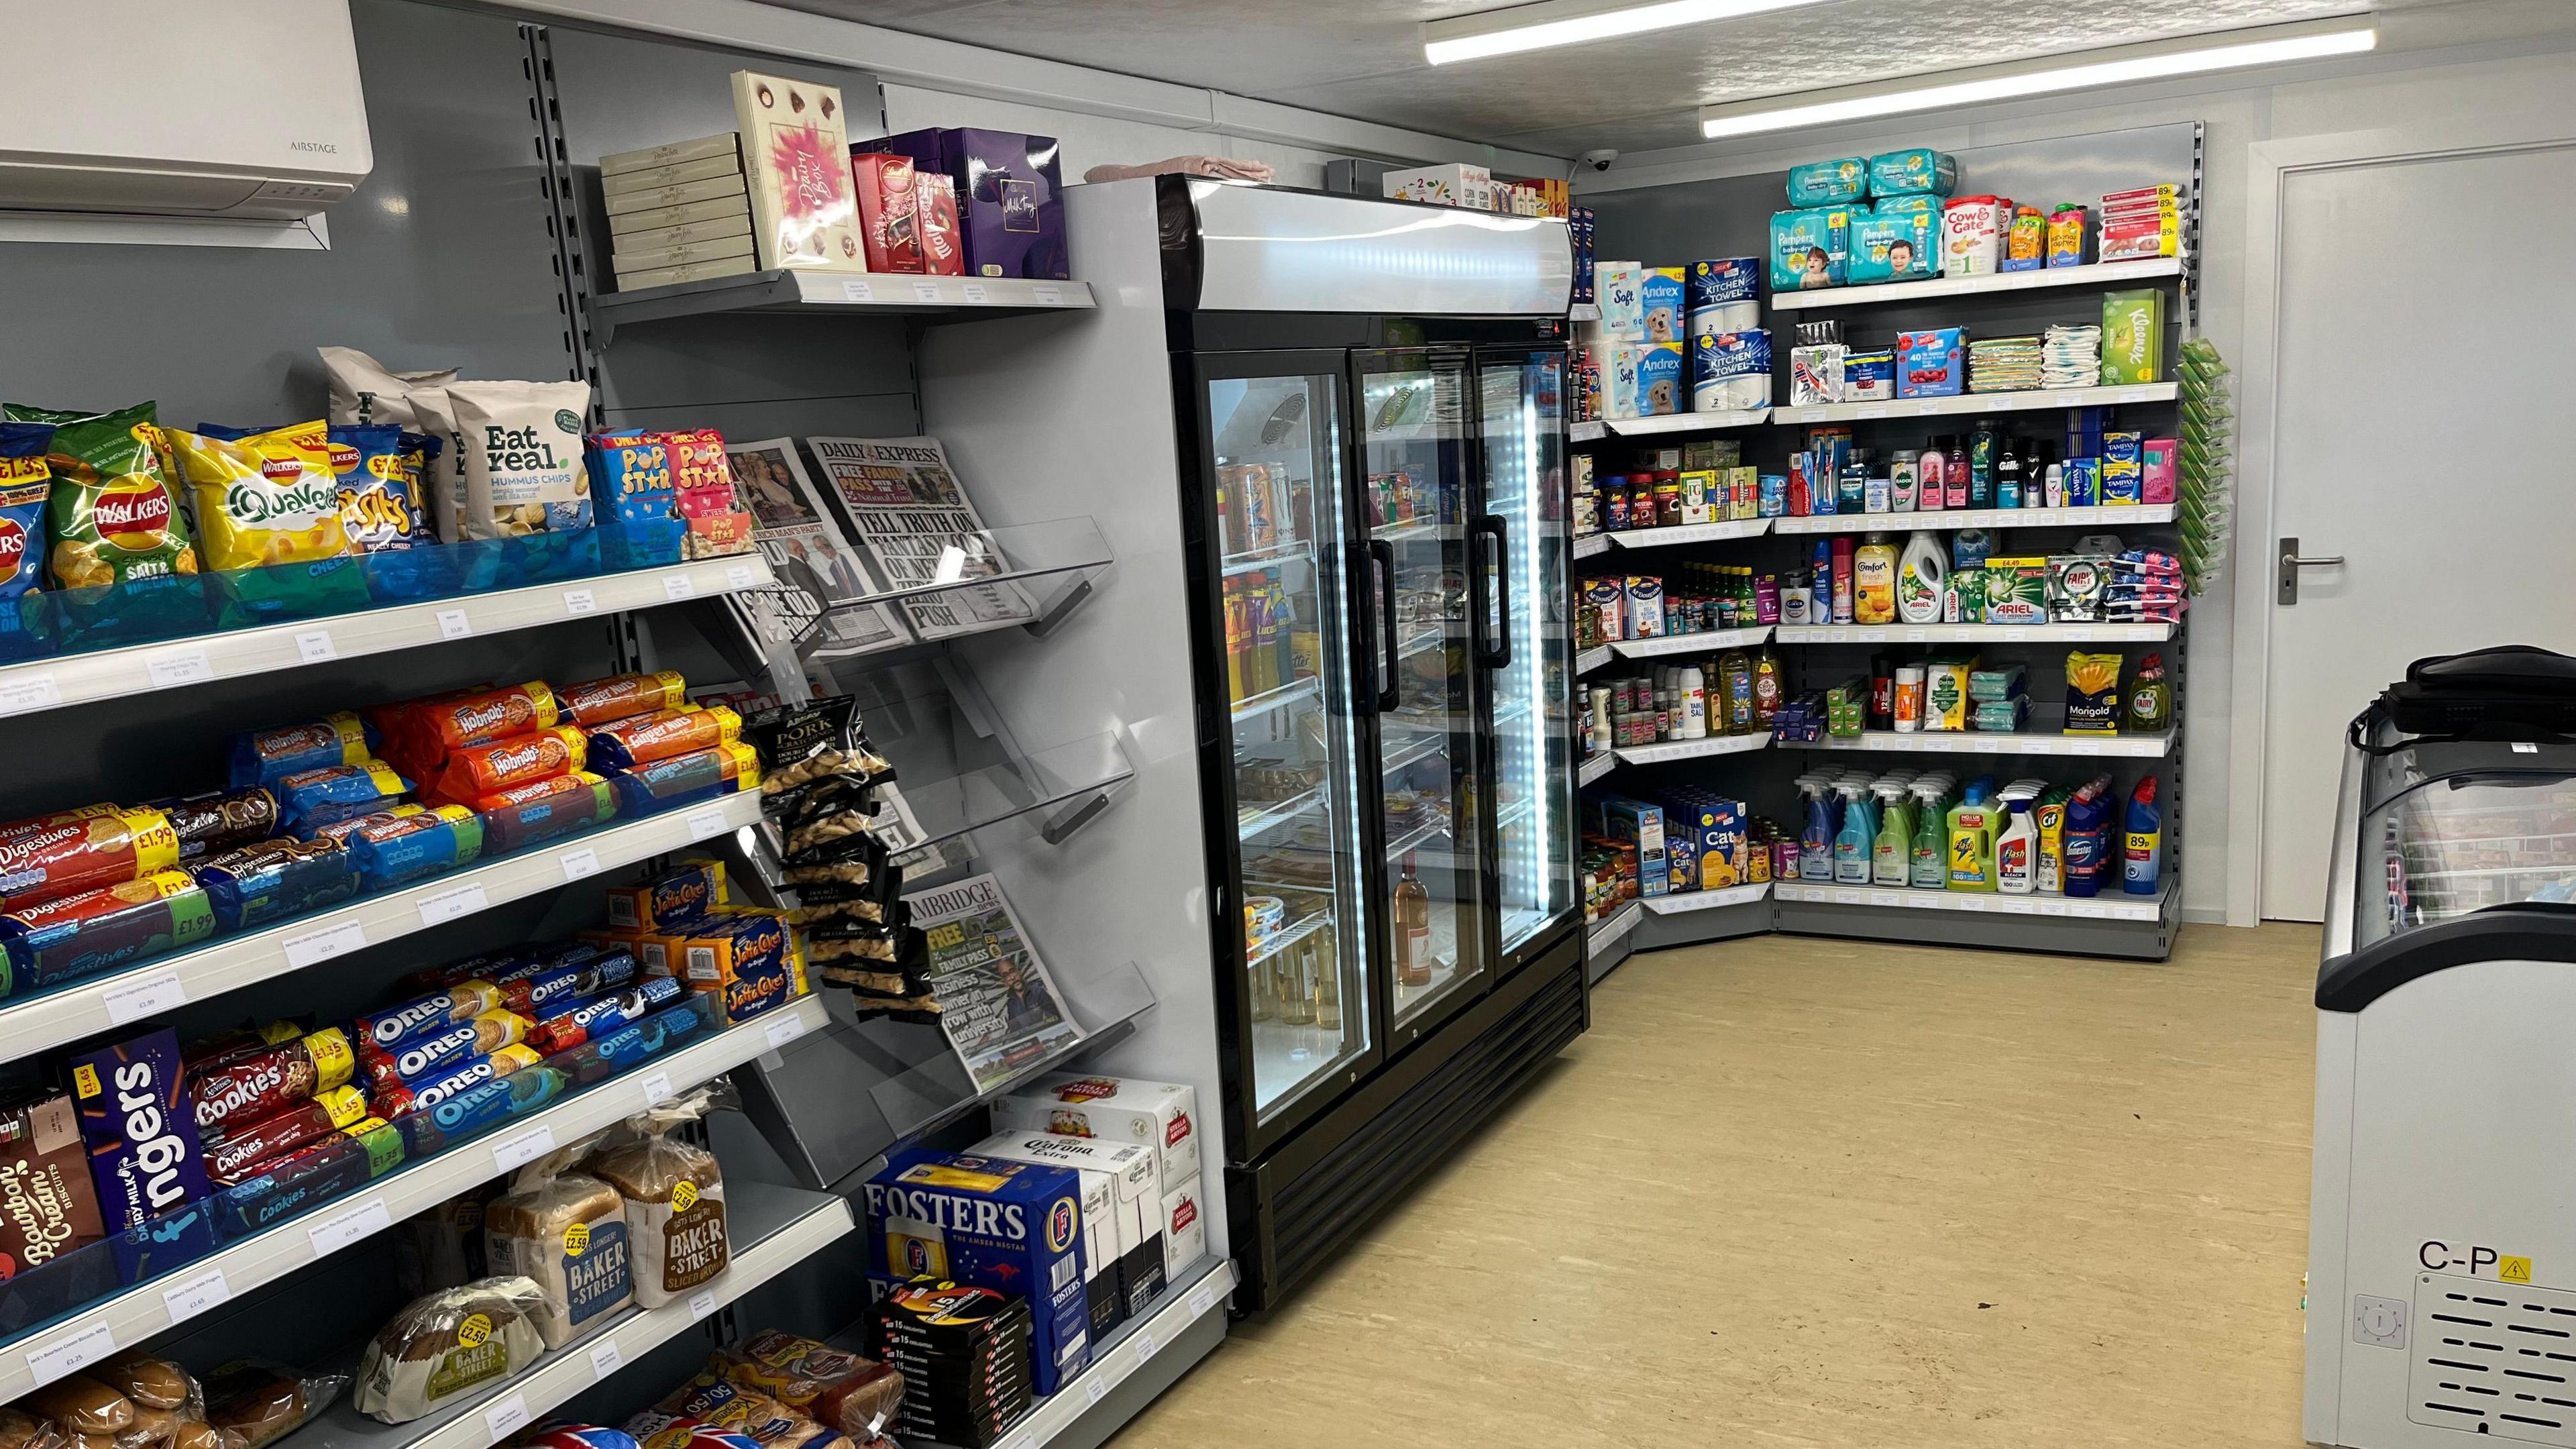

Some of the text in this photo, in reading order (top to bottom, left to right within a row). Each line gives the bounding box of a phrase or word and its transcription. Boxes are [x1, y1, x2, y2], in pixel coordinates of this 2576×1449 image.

[290, 142, 337, 154] AIRSTAGE
[1417, 178, 1424, 188] 2
[2159, 187, 2170, 195] 89p
[1479, 191, 1489, 201] CORN
[2160, 199, 2172, 207] 89p
[1948, 208, 1990, 223] Cow &
[1863, 229, 1895, 239] Pampers
[1953, 220, 1984, 233] Gate
[2162, 228, 2174, 236] 89p
[1778, 234, 1814, 246] Pampers
[1963, 256, 1971, 273] 1
[1644, 286, 1678, 297] Andrex
[1706, 278, 1747, 295] KITCHEN
[1614, 290, 1635, 304] Soft
[1711, 290, 1743, 303] TOWEL
[2129, 308, 2149, 365] Kleenex
[1644, 358, 1679, 370] Andrex
[1711, 352, 1752, 368] KITCHEN
[1911, 353, 1921, 361] 40
[1620, 368, 1634, 383] Soft
[1715, 362, 1749, 377] TOWEL
[486, 425, 539, 449] Eat
[818, 442, 941, 463] DAILY EXPRESS
[2108, 443, 2135, 451] TAMPAX
[488, 443, 556, 472] real
[262, 461, 303, 474] WALKERS
[491, 474, 571, 487] HUMMUS CHIPS
[839, 477, 874, 492] PASS
[2107, 479, 2134, 488] TAMPAX
[857, 491, 913, 502] National Trust
[1688, 484, 1701, 497] PG
[94, 494, 169, 525] WALKERS
[757, 523, 825, 539] RICH MAN'S PARTY
[854, 512, 979, 534] TELL TRUTH ON
[367, 541, 412, 551] REALLY CHEESY
[125, 561, 169, 580] SALT &
[1858, 561, 1887, 572] Comfort
[2067, 572, 2093, 585] FAIRY
[909, 606, 961, 629] PUSH
[1996, 604, 2033, 614] ARIEL
[574, 679, 638, 710] Ginger Nuts
[2070, 705, 2110, 718] Marigold
[2136, 699, 2153, 708] FAIRY
[459, 702, 506, 735] Hobnobs
[1691, 709, 1704, 717] SALT
[629, 714, 692, 749] Ginger Nuts
[777, 719, 833, 745] PORK
[492, 745, 541, 775] Hobnobs
[2042, 812, 2056, 826] Cif
[0, 824, 81, 865] Digestives
[41, 839, 72, 853] ORIGINAL
[138, 826, 174, 849] £1.99
[1706, 831, 1734, 846] Cat
[1953, 838, 1974, 851] Flash
[2131, 836, 2149, 847] 89p
[2004, 848, 2026, 859] Flash
[21, 888, 105, 920] Digestives
[655, 881, 705, 917] Jaffa Cakes
[977, 898, 1001, 914] news
[178, 913, 213, 934] £1.99
[926, 923, 965, 951] FREE
[735, 931, 782, 968] Jaffa Cakes
[530, 973, 578, 1004] OREO
[729, 973, 784, 1012] Jaffa Cakes
[139, 1000, 155, 1008] £1.99
[574, 996, 618, 1025] OREO
[376, 996, 452, 1041] OREO
[418, 1020, 440, 1034] GOLDEN
[953, 1016, 1008, 1042] university
[598, 1028, 641, 1055] OREO
[315, 1042, 342, 1061] £1.35
[399, 1027, 477, 1075] OREO
[80, 1067, 91, 1094] £1.65
[417, 1063, 493, 1110] OREO
[196, 1065, 282, 1126] Cookies
[435, 1079, 511, 1125] OREO
[332, 1100, 360, 1118] £1.35
[217, 1137, 264, 1173] Cookies
[1024, 1139, 1095, 1156] Corona
[1032, 1148, 1069, 1160] Extra
[373, 1149, 397, 1168] £1.35
[48, 1163, 73, 1210] BISCUITS
[259, 1187, 306, 1223] Cookies
[672, 1191, 692, 1209] £2.59
[864, 1183, 1026, 1240] FOSTER'S
[566, 1238, 587, 1249] £2.59
[670, 1218, 724, 1258] BAKER
[953, 1234, 1026, 1252] THE AMBER NECTAR
[570, 1240, 626, 1291] BAKER
[676, 1243, 718, 1275] STREET
[2419, 1241, 2498, 1275] C-P
[579, 1269, 621, 1304] STREET
[1051, 1278, 1081, 1308] FOSTER'S
[190, 1297, 205, 1308] £1.65
[929, 1296, 956, 1309] 15
[460, 1326, 486, 1344] £2.59
[44, 1346, 63, 1358] Bourbon
[66, 1354, 83, 1366] £1.25
[455, 1342, 496, 1370] BAKER
[460, 1358, 493, 1378] STREET
[896, 1361, 904, 1371] 15
[903, 1411, 911, 1420] 15
[902, 1426, 911, 1436] 15
